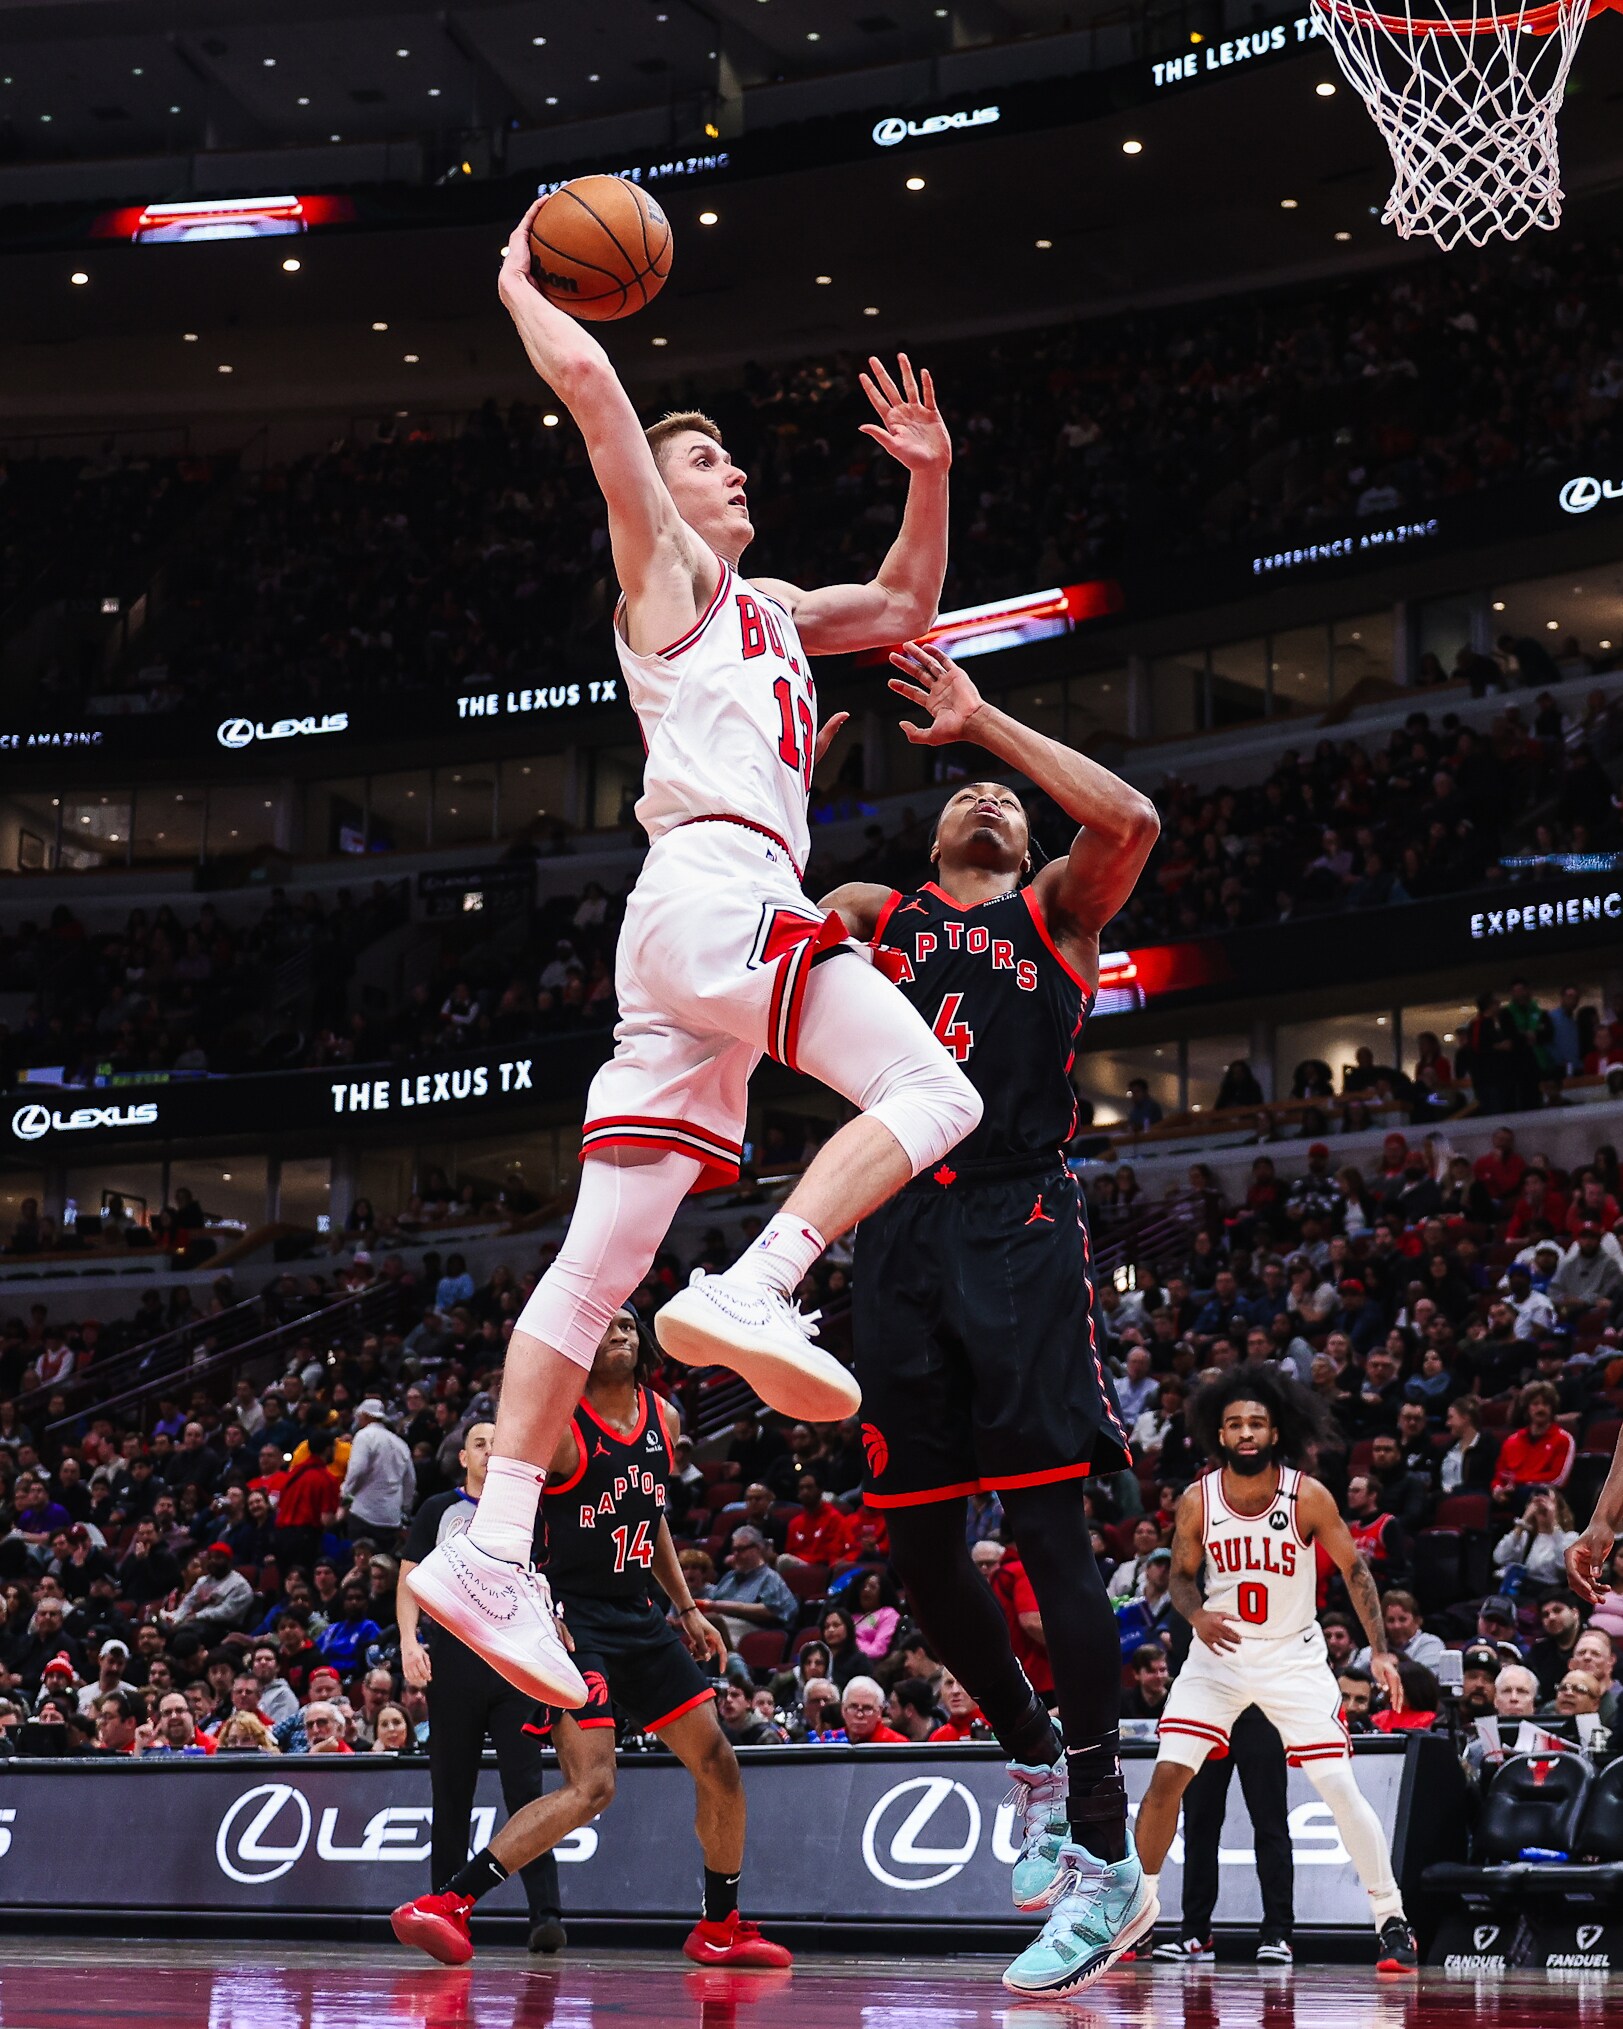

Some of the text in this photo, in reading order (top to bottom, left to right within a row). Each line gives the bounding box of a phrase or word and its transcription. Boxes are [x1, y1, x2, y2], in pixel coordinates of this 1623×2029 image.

[1152, 13, 1325, 86] THE LEXUS TX
[908, 105, 1000, 136] LEXUS
[647, 152, 729, 180] AMAZING
[1253, 518, 1438, 575] EXPERIENCE AMAZING
[456, 679, 617, 718] THE LEXUS TX
[26, 731, 103, 747] AMAZING
[255, 712, 349, 740] LEXUS
[1470, 892, 1622, 939] EXPERIENC
[893, 921, 1038, 992] APTORS
[932, 992, 974, 1062] 4
[331, 1059, 533, 1112] THE LEXUS TX
[52, 1103, 158, 1130] LEXUS
[611, 1520, 654, 1573] 14
[1208, 1536, 1297, 1577] BULLS
[1237, 1581, 1268, 1625] 0
[1444, 1954, 1507, 1968] FANDUEL
[1545, 1953, 1611, 1967] FANDUEL
